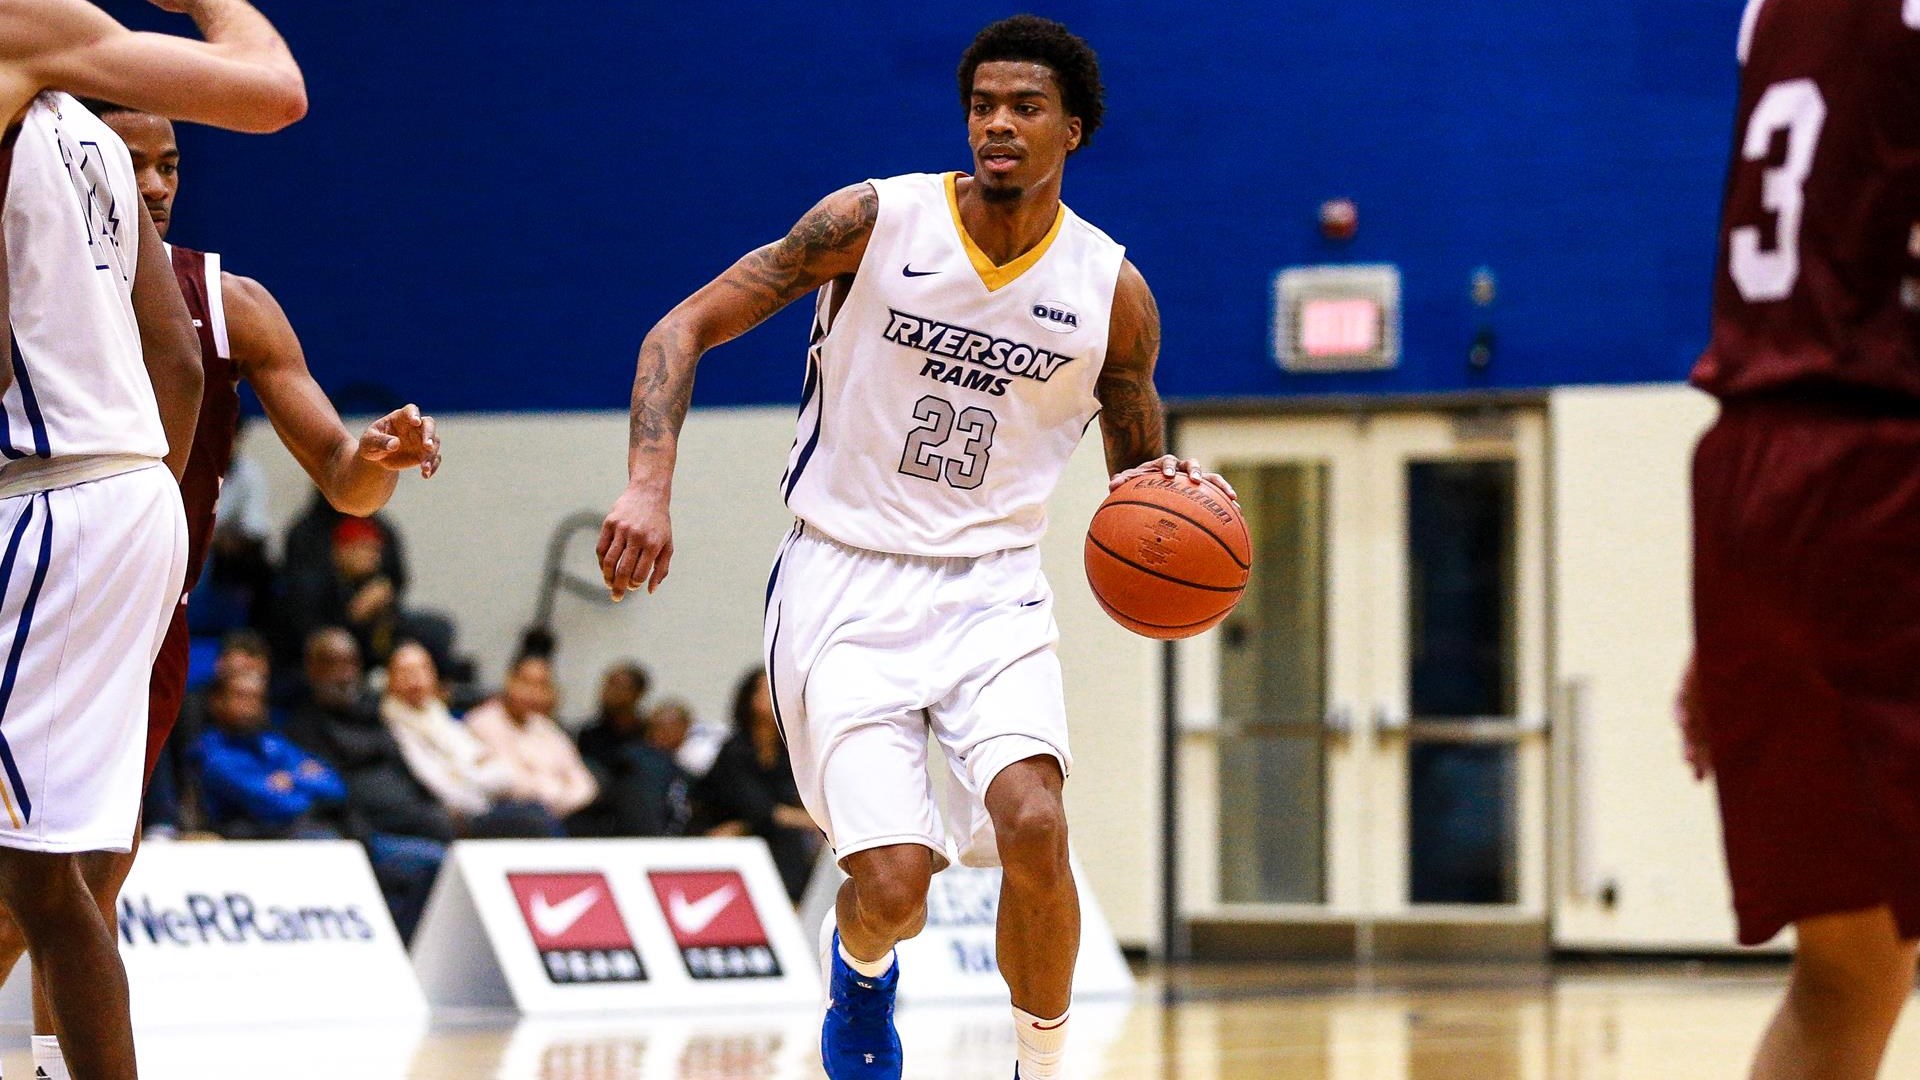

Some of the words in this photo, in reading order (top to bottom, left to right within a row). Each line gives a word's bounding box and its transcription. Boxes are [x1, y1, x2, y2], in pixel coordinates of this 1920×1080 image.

[1728, 78, 1827, 302] 3
[1032, 304, 1078, 328] OUA
[883, 308, 1074, 382] RYERSON
[920, 357, 1013, 396] RAMS
[898, 394, 997, 490] 23
[546, 951, 641, 980] TEAM
[683, 946, 775, 977] TEAM
